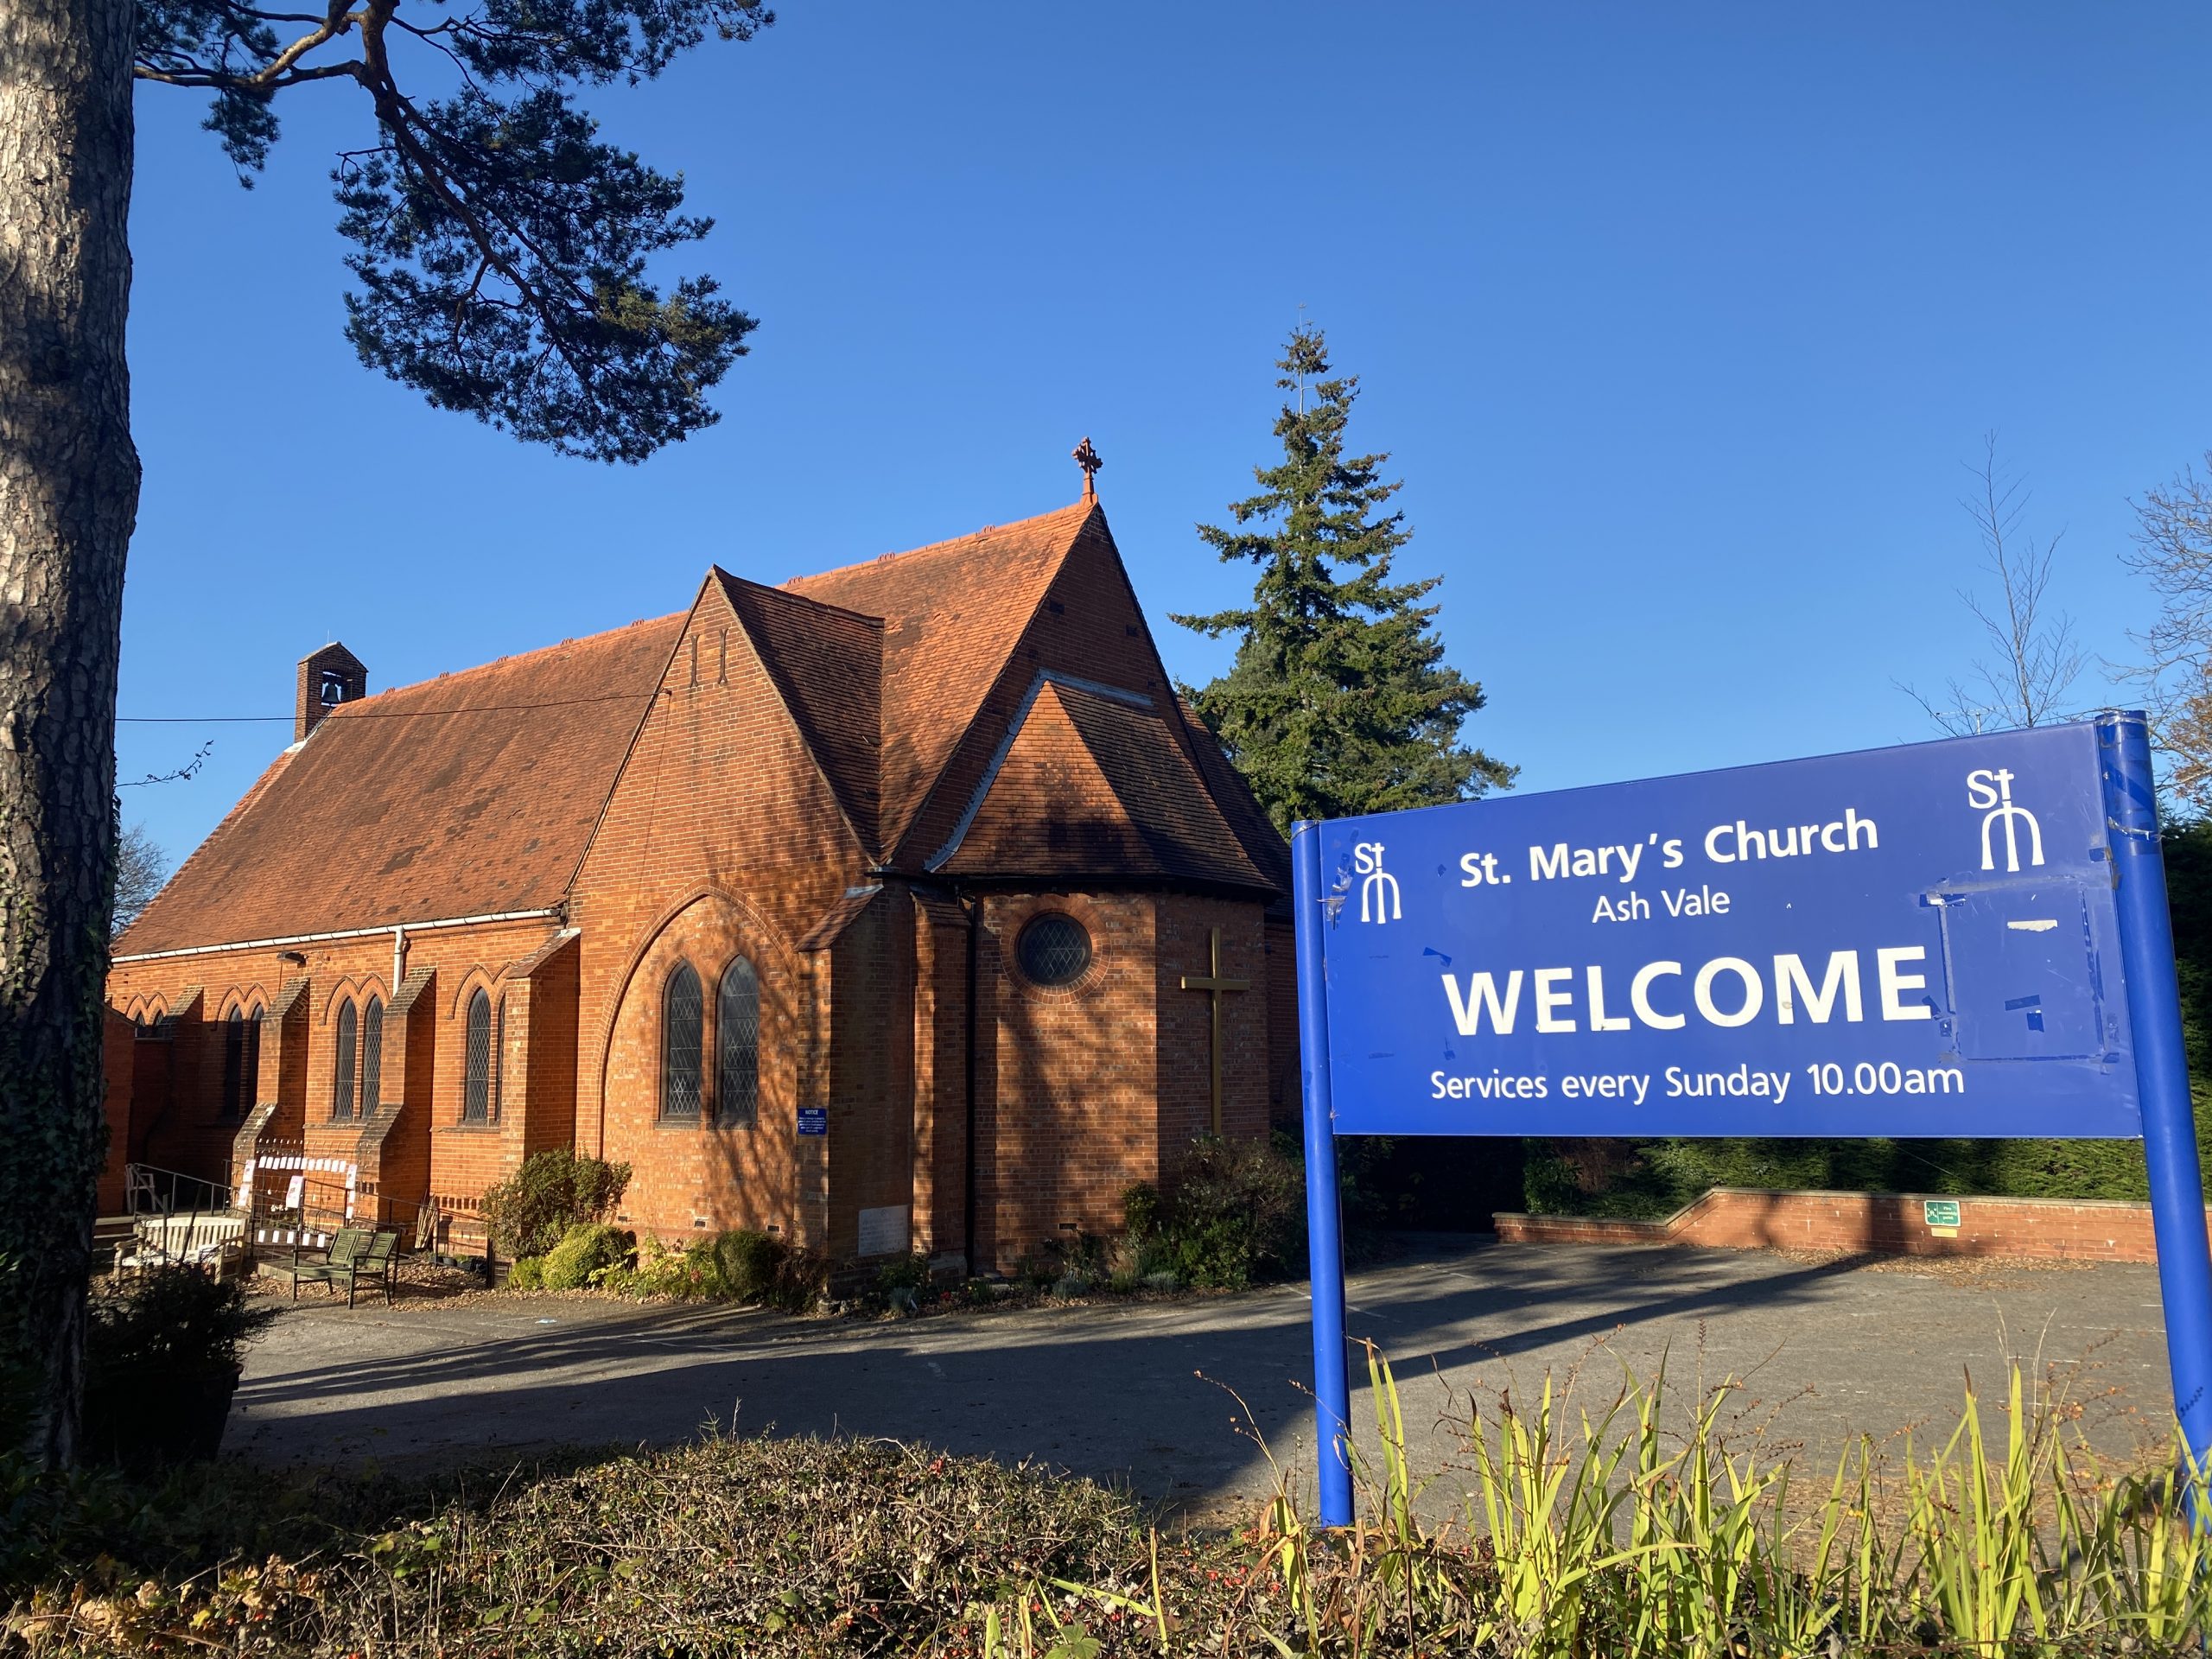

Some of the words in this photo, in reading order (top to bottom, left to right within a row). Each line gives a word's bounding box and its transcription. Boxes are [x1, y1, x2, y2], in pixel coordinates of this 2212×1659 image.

[1967, 768, 2015, 810] St
[1354, 842, 1385, 874] St
[1459, 852, 1511, 887] St.
[1529, 833, 1684, 883] Mary's
[1705, 808, 1878, 863] Church
[1592, 891, 1650, 924] Ash
[1660, 884, 1731, 918] Vale
[1441, 945, 1932, 1036] WELCOME
[1431, 1071, 1548, 1100] Services
[1561, 1074, 1650, 1106] every
[1665, 1066, 1791, 1104] Sunday
[1806, 1061, 1965, 1095] 10.00am
